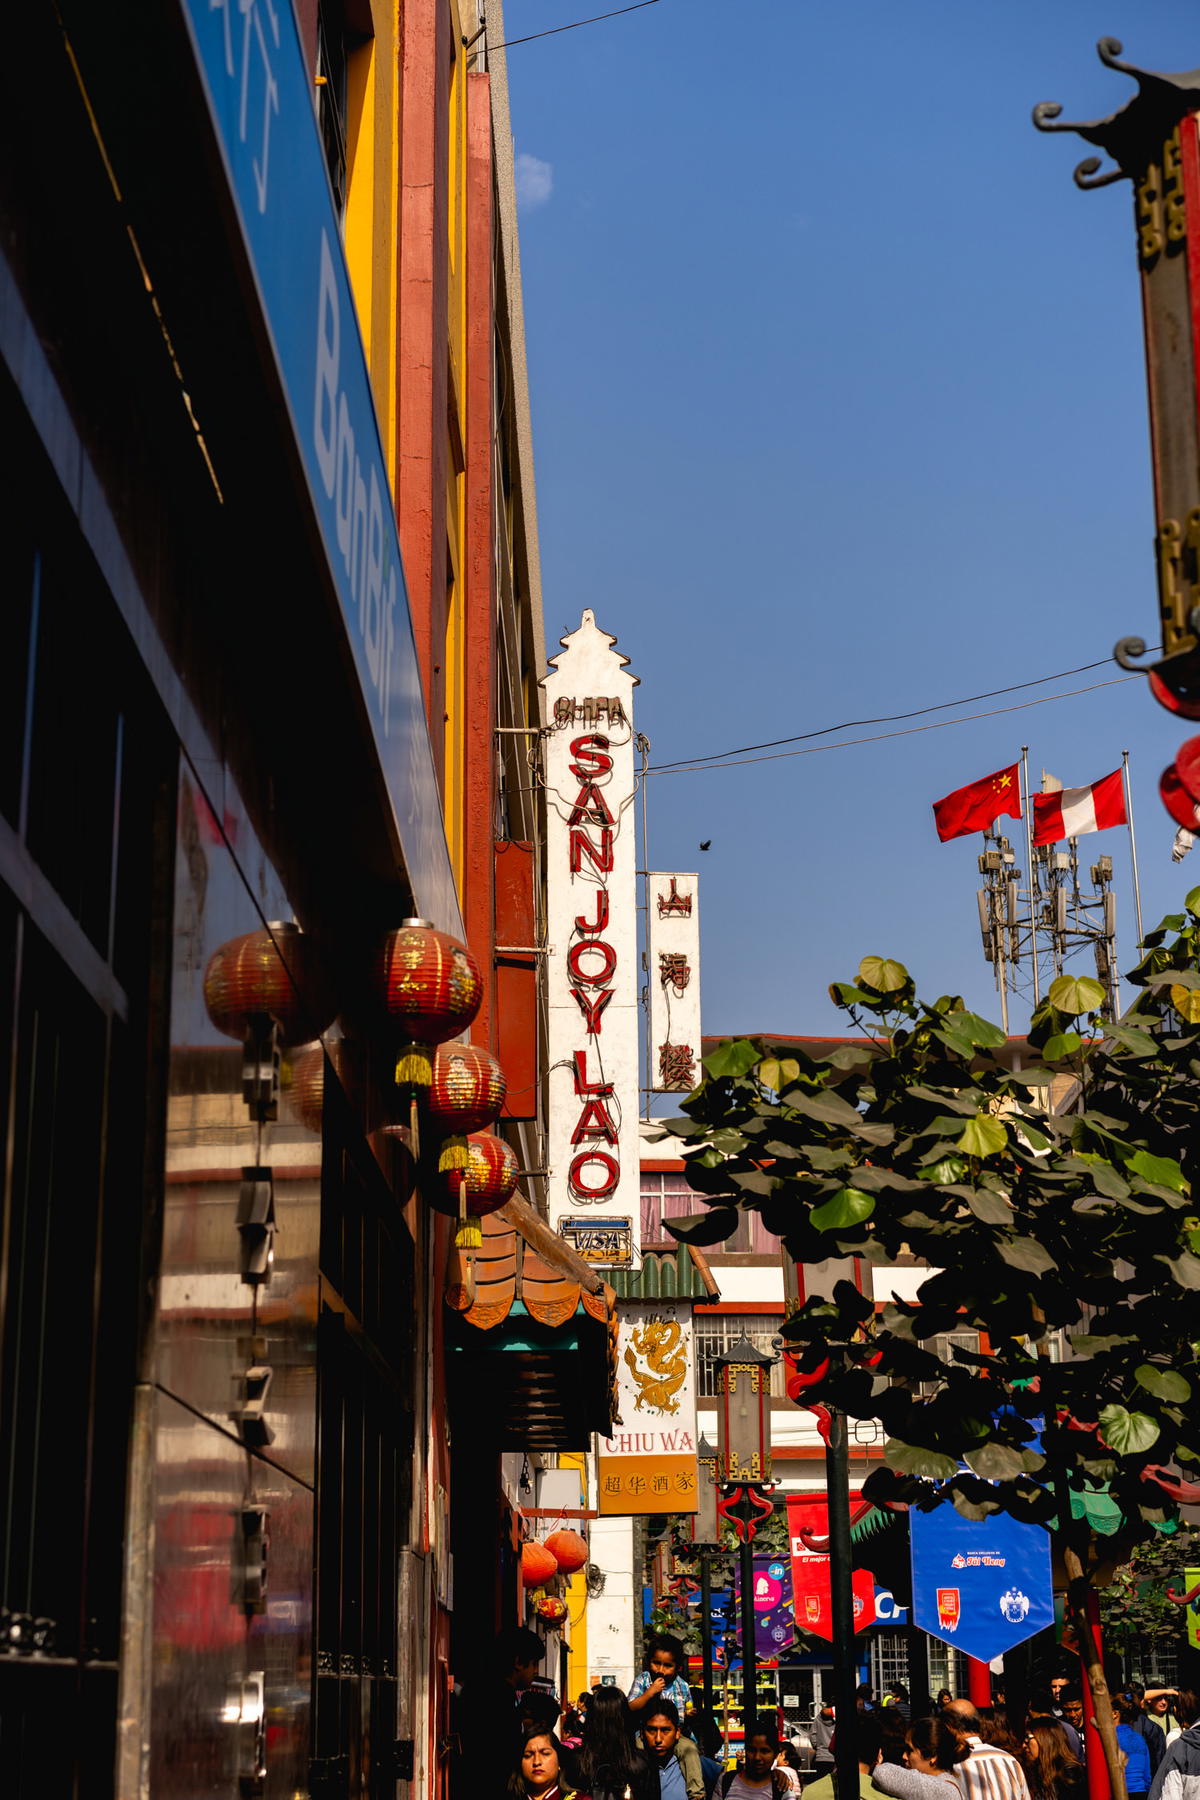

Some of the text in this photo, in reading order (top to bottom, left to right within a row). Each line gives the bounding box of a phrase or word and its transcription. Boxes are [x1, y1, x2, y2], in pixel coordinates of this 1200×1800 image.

[313, 226, 396, 737] BanBif
[567, 735, 621, 1198] SAN JOY LAO
[575, 1231, 621, 1249] VISA
[606, 1428, 694, 1453] CHIU WA
[604, 1471, 694, 1494] 超华酒家
[809, 1556, 827, 1564] mejor
